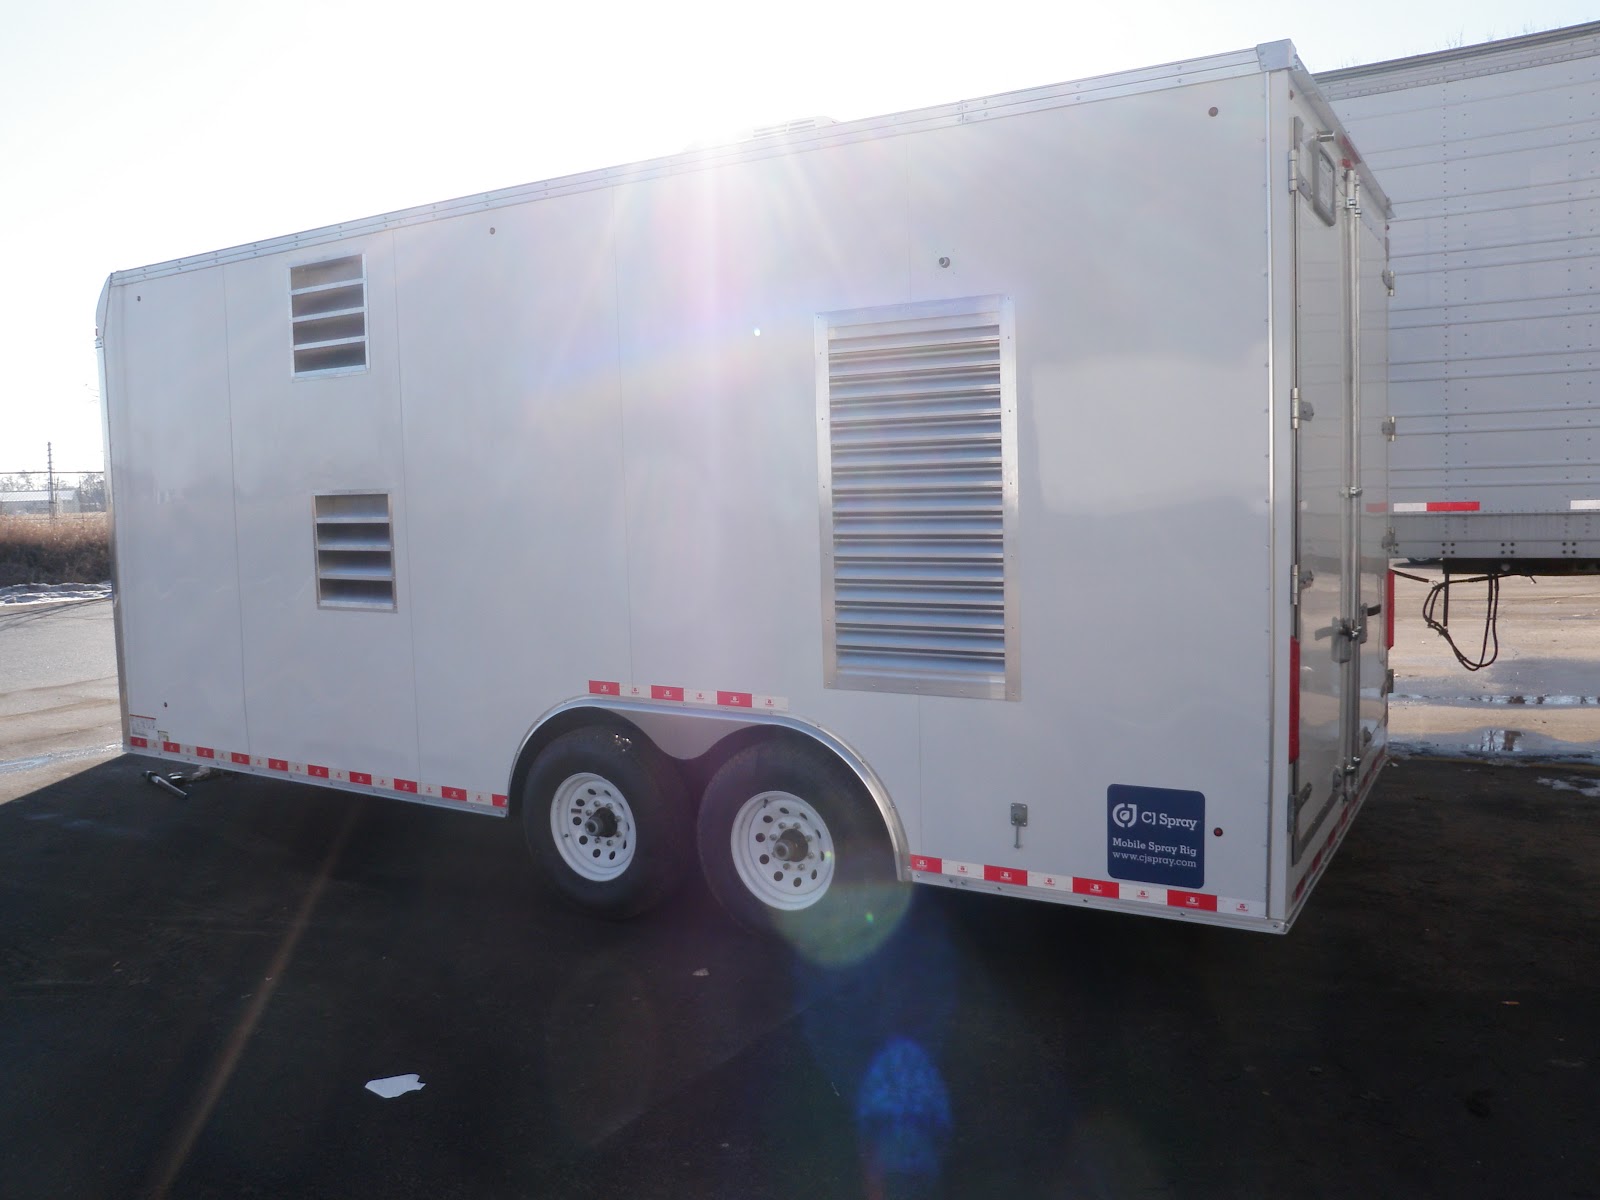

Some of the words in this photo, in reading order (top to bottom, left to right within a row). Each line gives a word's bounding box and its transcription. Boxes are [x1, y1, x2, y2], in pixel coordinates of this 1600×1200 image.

[1141, 811, 1156, 825] CJ
[1159, 813, 1197, 831] Spray
[1112, 837, 1146, 849] Mobile
[1148, 841, 1177, 854] Spray
[1179, 845, 1197, 857] Rig
[1112, 851, 1197, 868] www.cjspray.com
